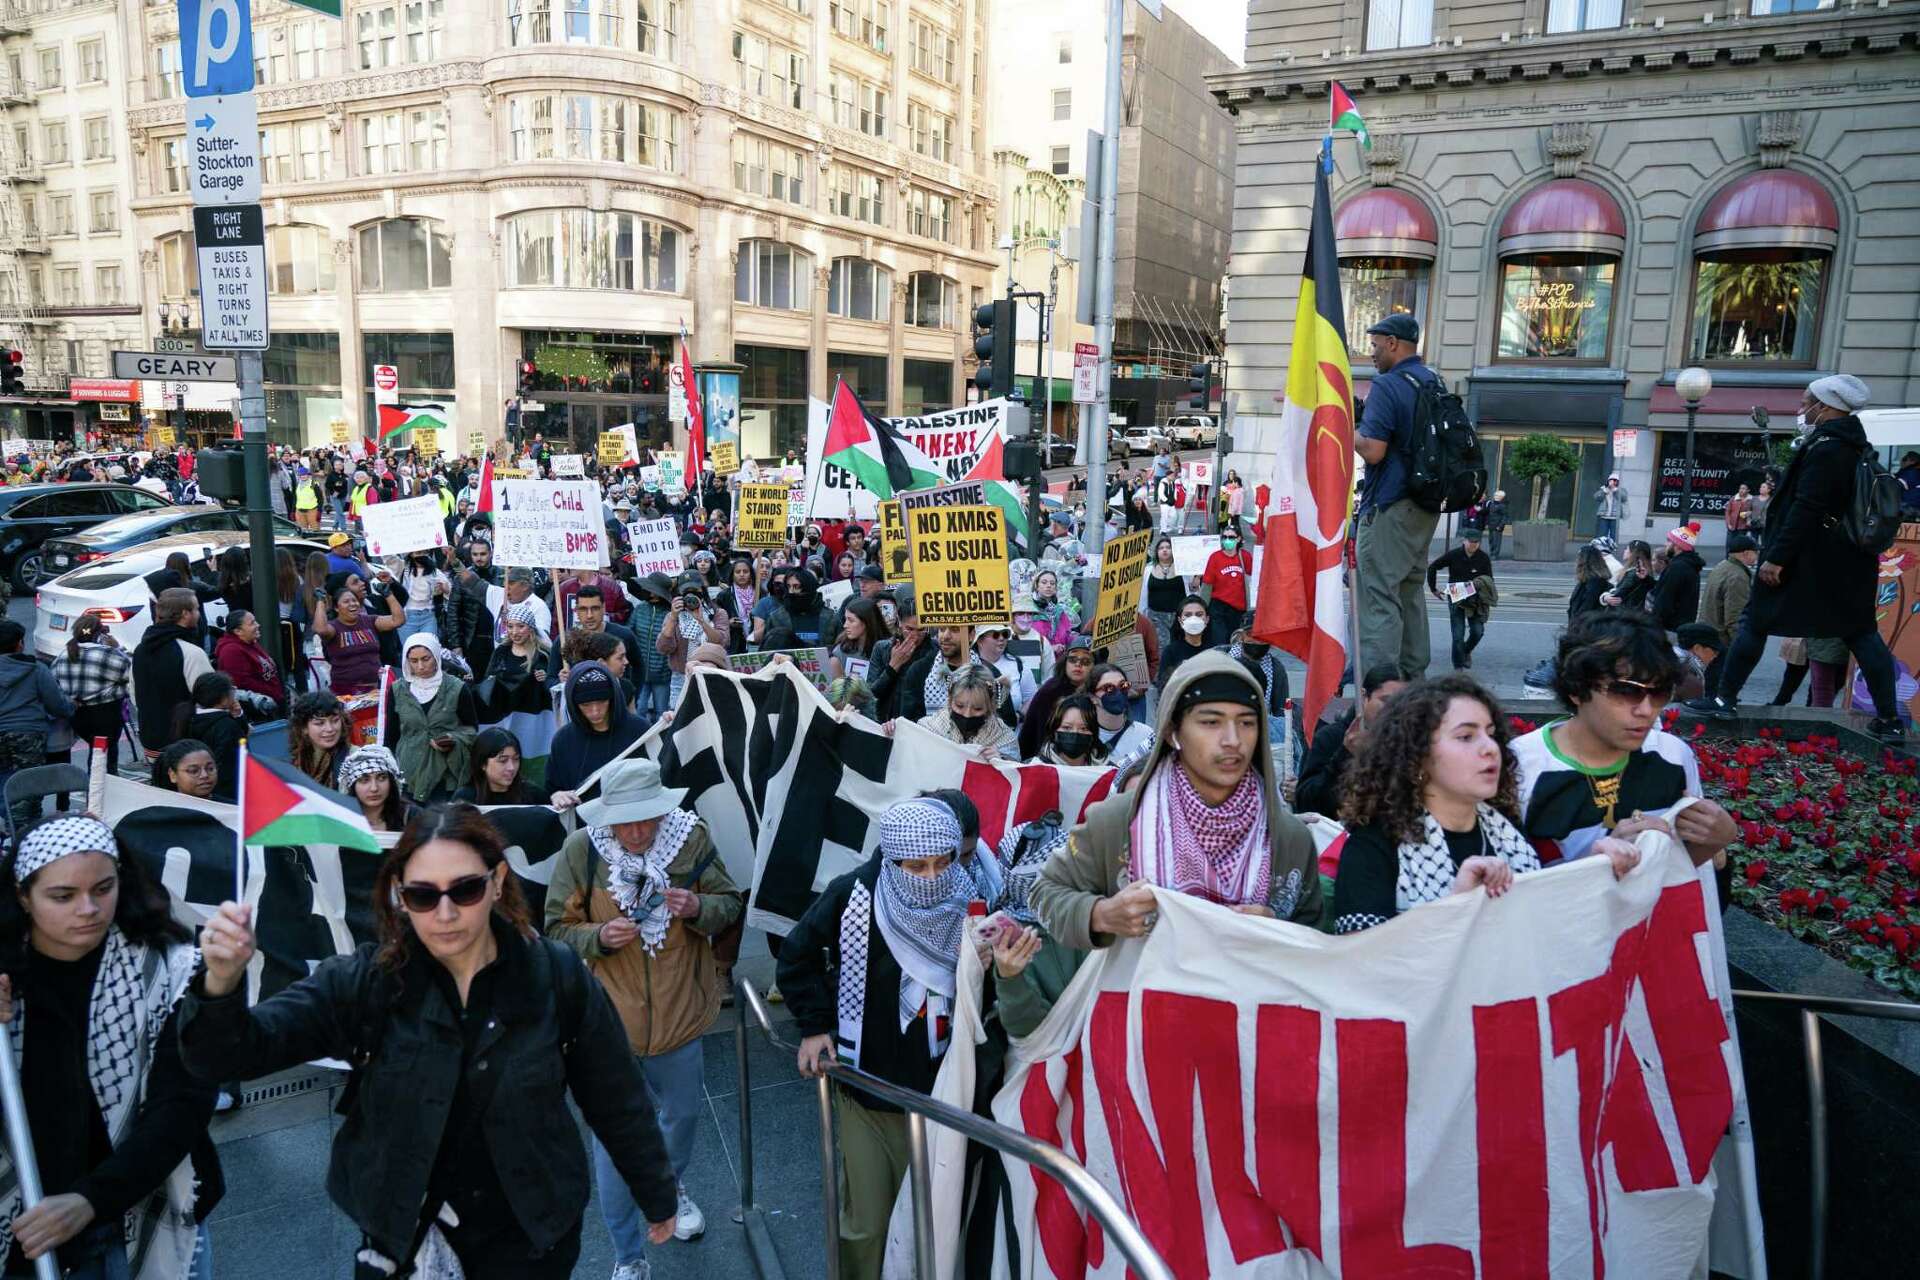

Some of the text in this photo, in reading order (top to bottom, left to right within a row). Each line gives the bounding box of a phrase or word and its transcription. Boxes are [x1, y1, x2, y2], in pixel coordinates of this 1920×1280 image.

[197, 137, 239, 152] Sutter-
[198, 154, 253, 171] Stockton
[199, 174, 244, 191] Garage
[213, 212, 242, 225] RIGHT
[216, 227, 242, 239] LANE
[214, 251, 248, 263] BUSES
[212, 266, 252, 279] TAXIS &
[218, 283, 248, 295] RIGHT
[1536, 283, 1574, 297] #POP
[218, 299, 251, 311] TURNS
[221, 314, 248, 326] ONLY
[208, 330, 263, 342] AT ALL TIMES
[159, 339, 183, 351] 300
[137, 358, 217, 376] GEARY
[175, 384, 188, 392] 20
[890, 406, 999, 429] PALESTINE
[1734, 449, 1766, 460] Union
[553, 489, 584, 511] Child
[742, 487, 788, 500] THE WORLD
[746, 503, 782, 515] STANDS
[1659, 497, 1680, 508] 415
[753, 518, 774, 530] WITH
[788, 515, 805, 525] OW
[917, 512, 940, 534] NO
[946, 511, 998, 533] XMAS
[632, 521, 670, 536] END US
[566, 532, 598, 553] BOMBS
[739, 530, 785, 542] PALESTINE!
[637, 540, 674, 554] AID TO
[919, 539, 1002, 562] AS USUAL
[1106, 534, 1148, 564] NO XMAS
[640, 560, 680, 575] ISRAEL
[946, 569, 977, 588] IN A
[1102, 560, 1144, 592] AS USUAL
[922, 590, 1006, 612] GENOCIDE
[1113, 591, 1129, 611] IN A
[972, 614, 1005, 622] Coalition
[1097, 604, 1138, 636] GENOCIDE
